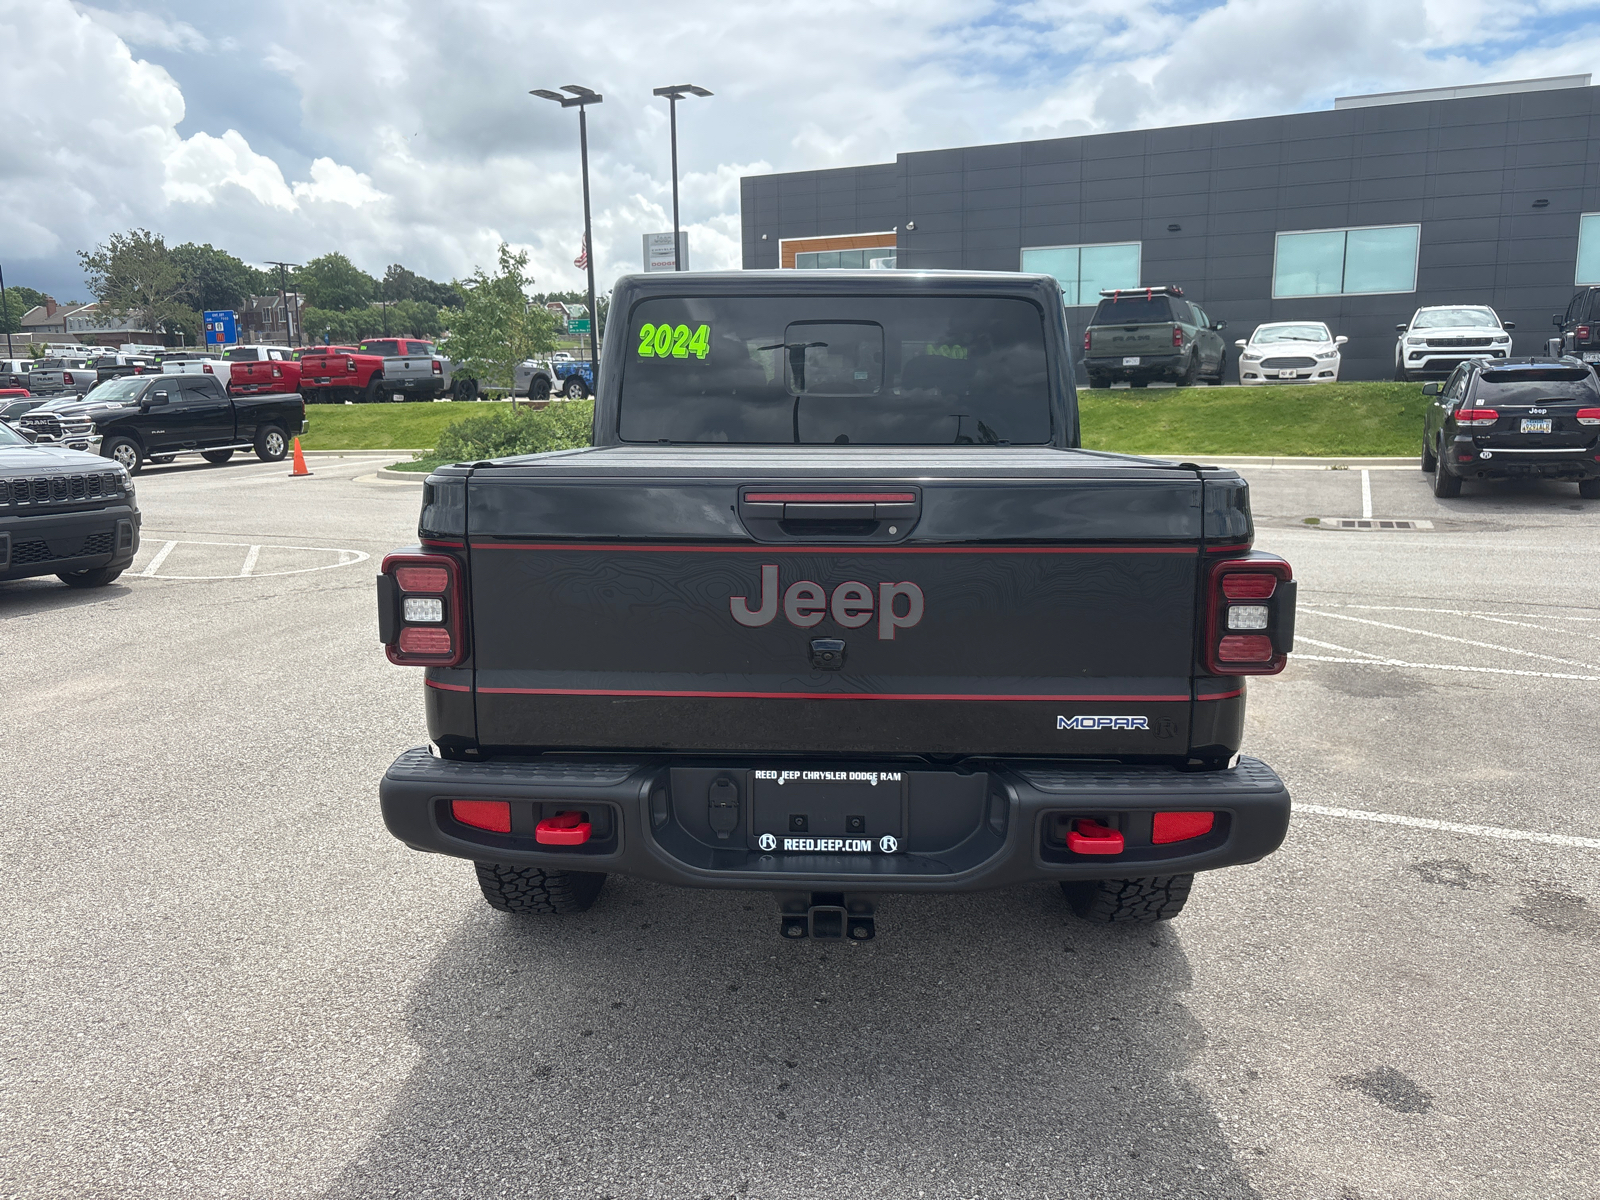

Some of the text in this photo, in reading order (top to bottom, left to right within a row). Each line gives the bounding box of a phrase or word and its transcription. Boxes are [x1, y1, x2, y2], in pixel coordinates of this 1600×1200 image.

[654, 235, 672, 244] Jeep
[638, 323, 711, 360] 2024
[1528, 407, 1548, 415] Jeep
[729, 564, 925, 641] Jeep
[1056, 715, 1150, 730] MOPAR
[755, 770, 901, 782] REED JEEP CHRYSLER DODGE RAM
[784, 838, 872, 852] REEDJEEP.COM
